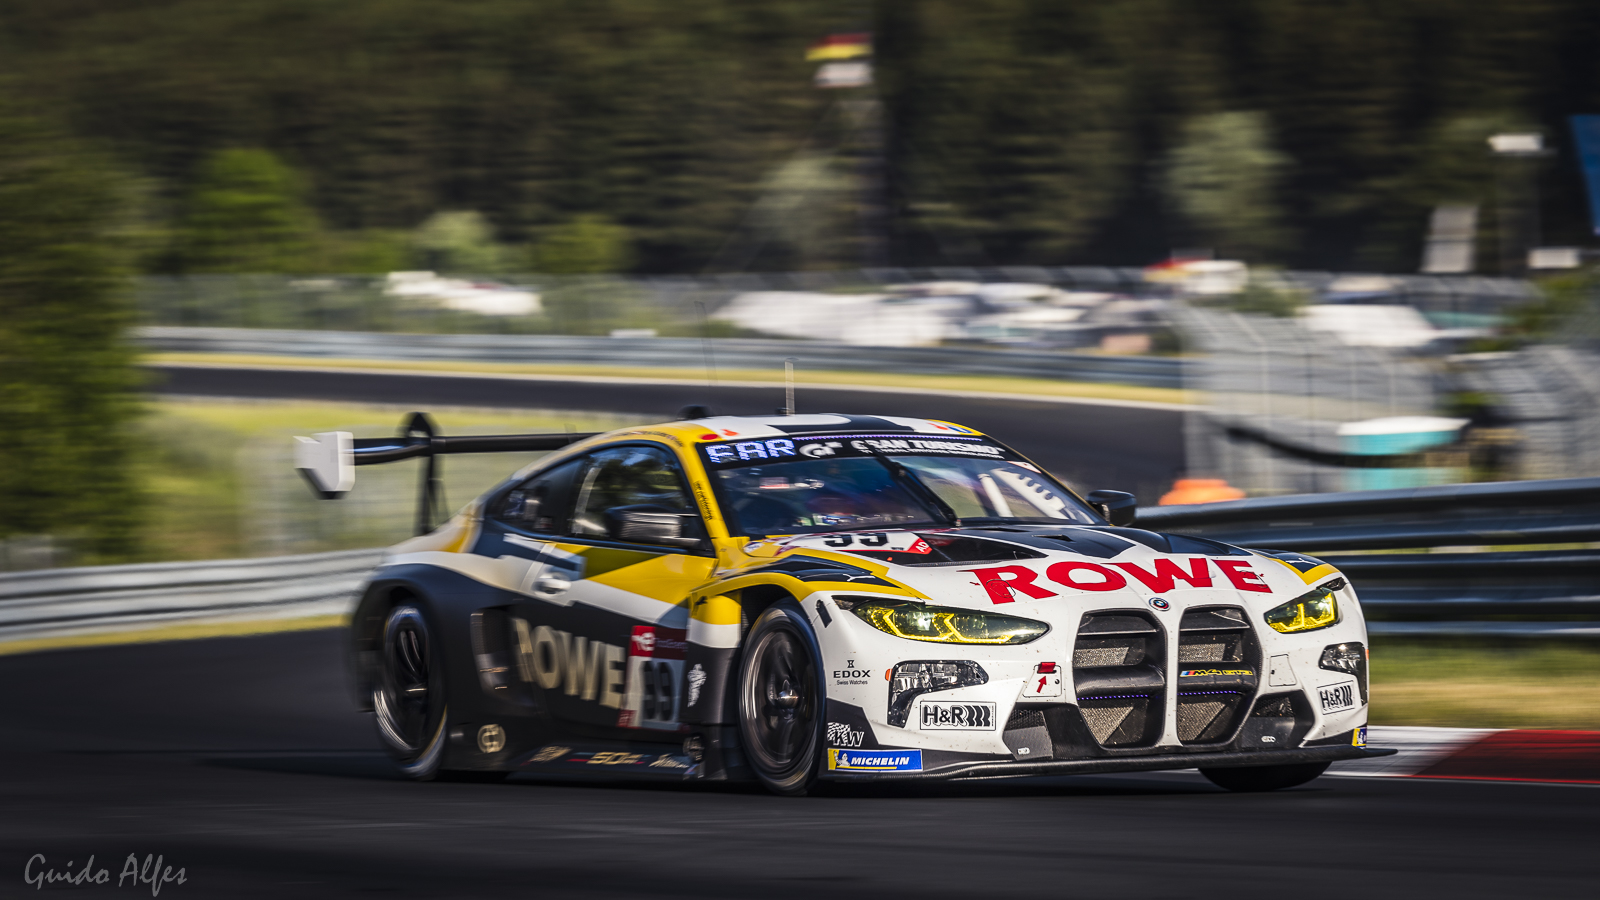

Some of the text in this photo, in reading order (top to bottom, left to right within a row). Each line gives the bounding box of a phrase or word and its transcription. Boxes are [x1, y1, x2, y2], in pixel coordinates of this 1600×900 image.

[959, 558, 1273, 605] ROWE
[833, 670, 871, 678] EDOX
[1320, 688, 1343, 710] H&R
[922, 705, 967, 726] H&R
[833, 731, 864, 747] KW
[850, 757, 910, 766] MICHELIN
